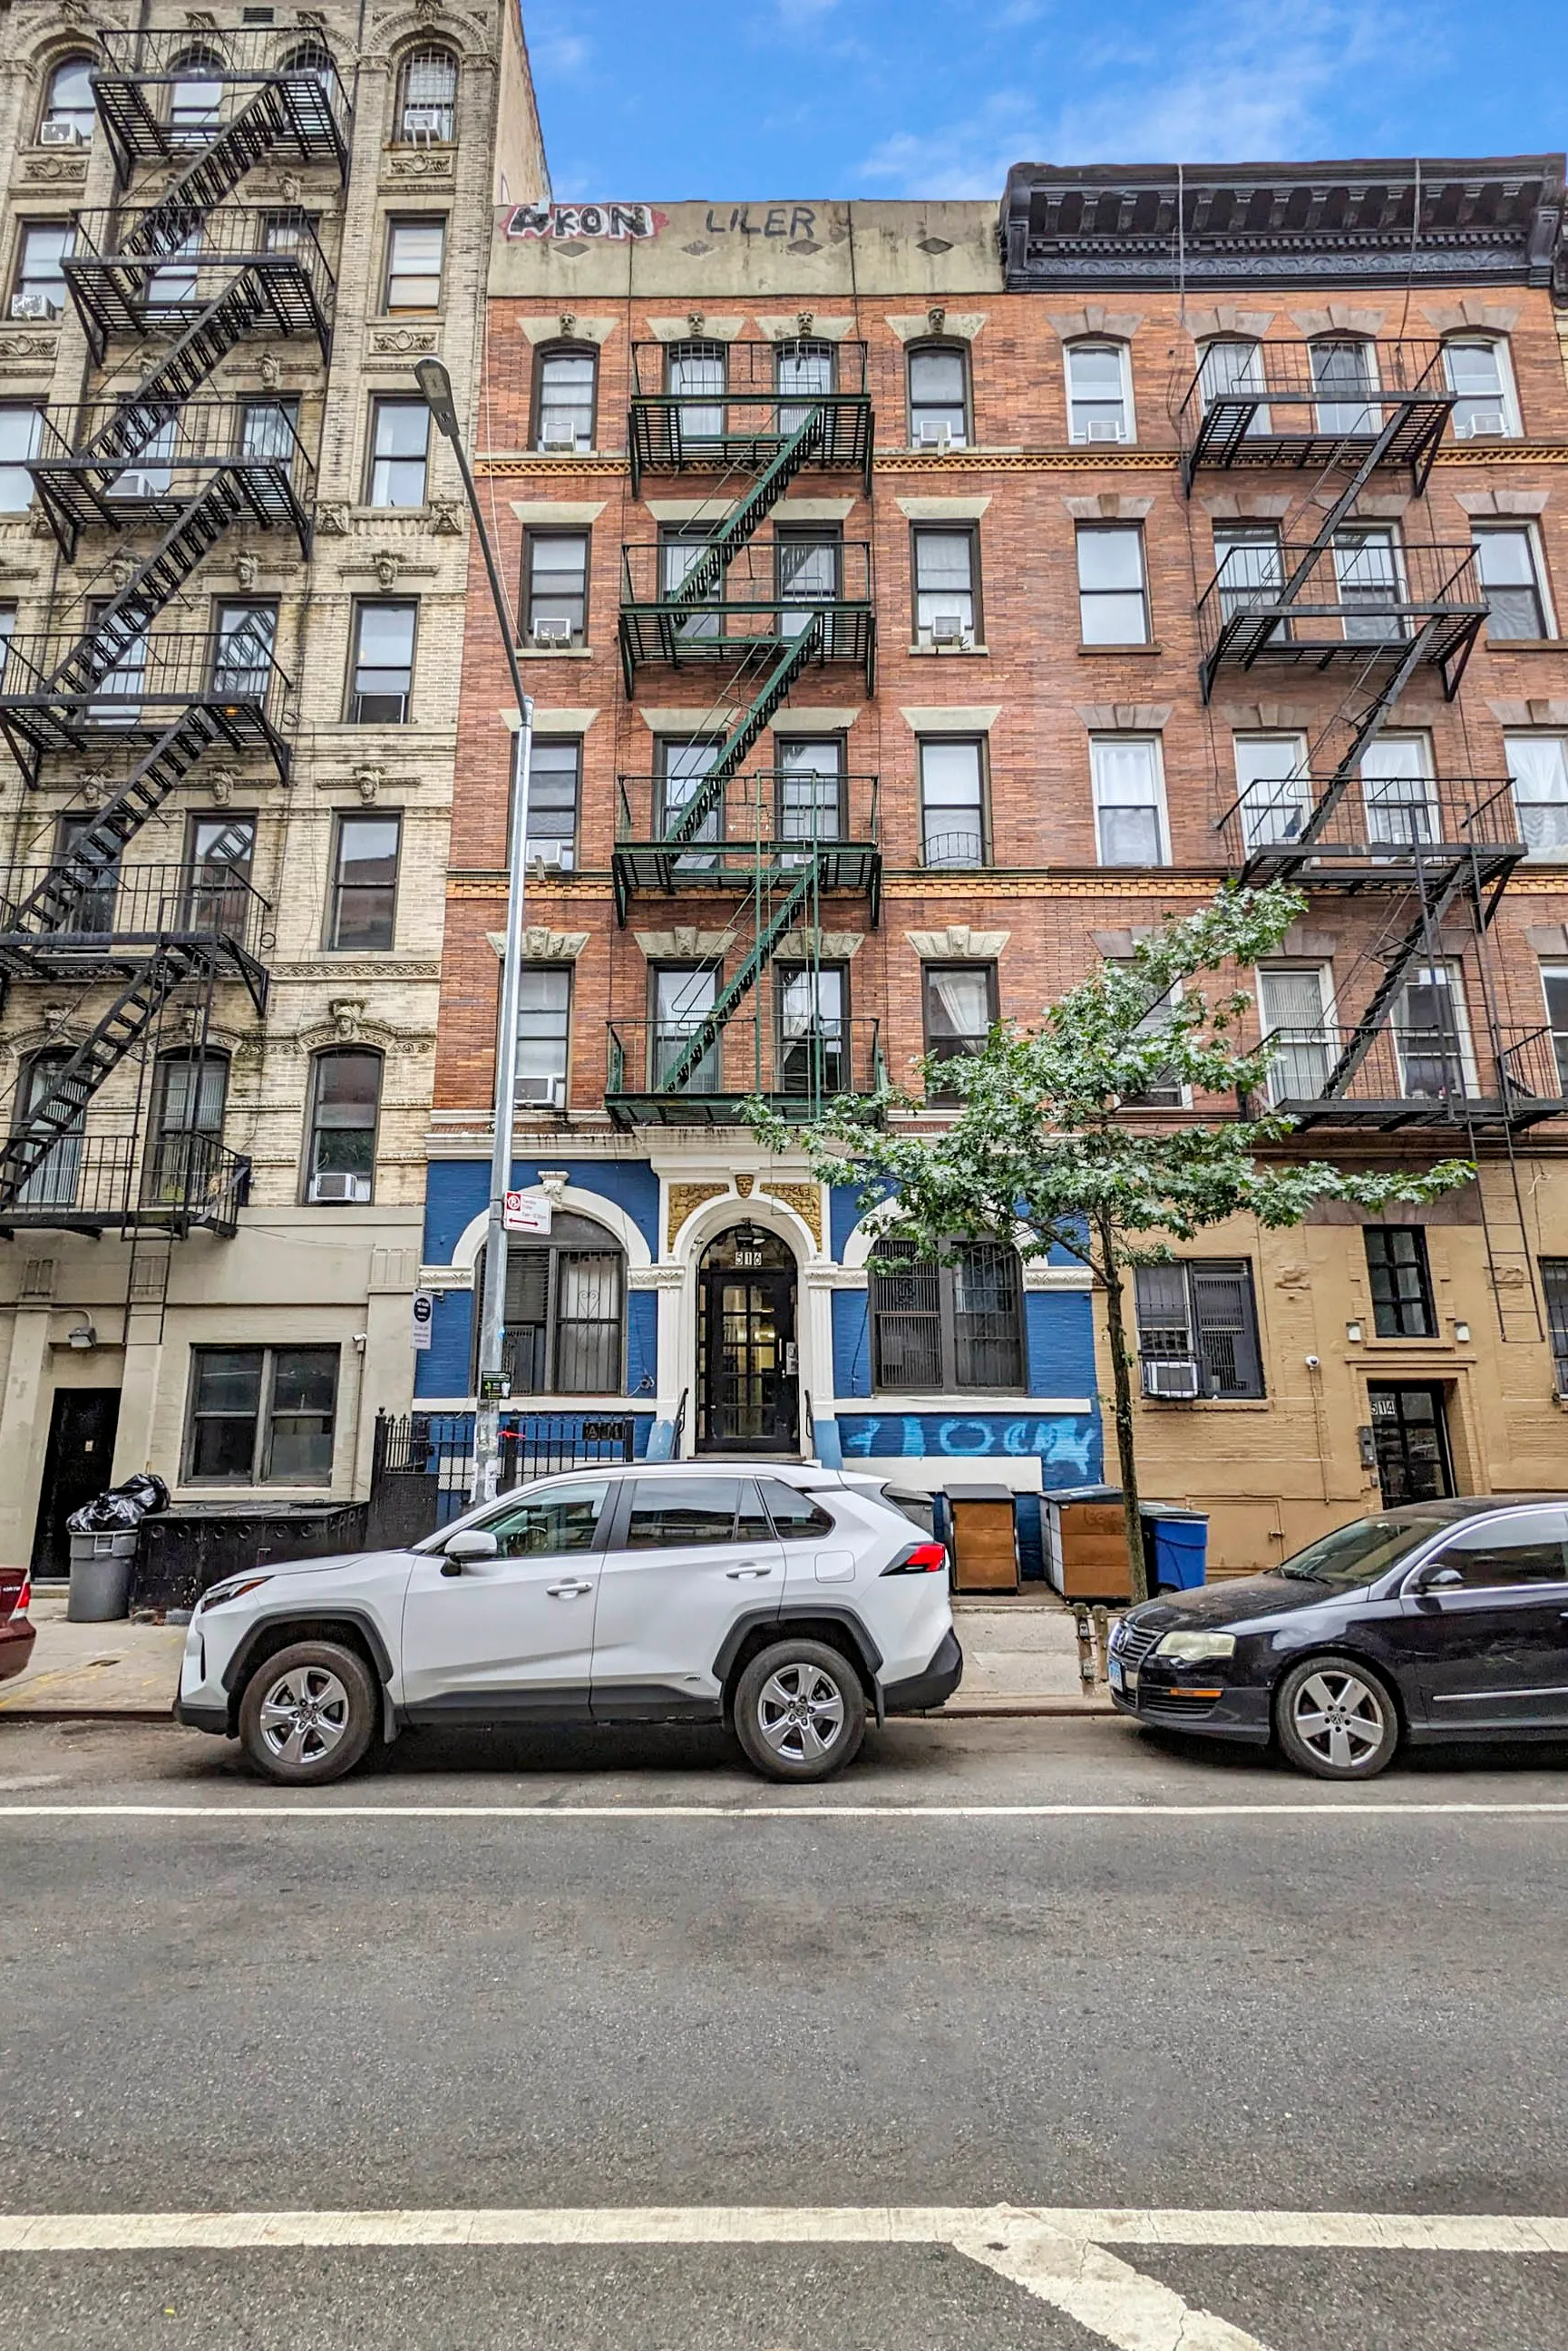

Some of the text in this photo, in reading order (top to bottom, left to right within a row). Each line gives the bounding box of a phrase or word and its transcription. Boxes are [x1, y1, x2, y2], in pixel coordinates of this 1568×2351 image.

[507, 205, 655, 239] AKON
[706, 207, 816, 239] LILER
[735, 1252, 762, 1265] 516
[1370, 1400, 1396, 1415] 514
